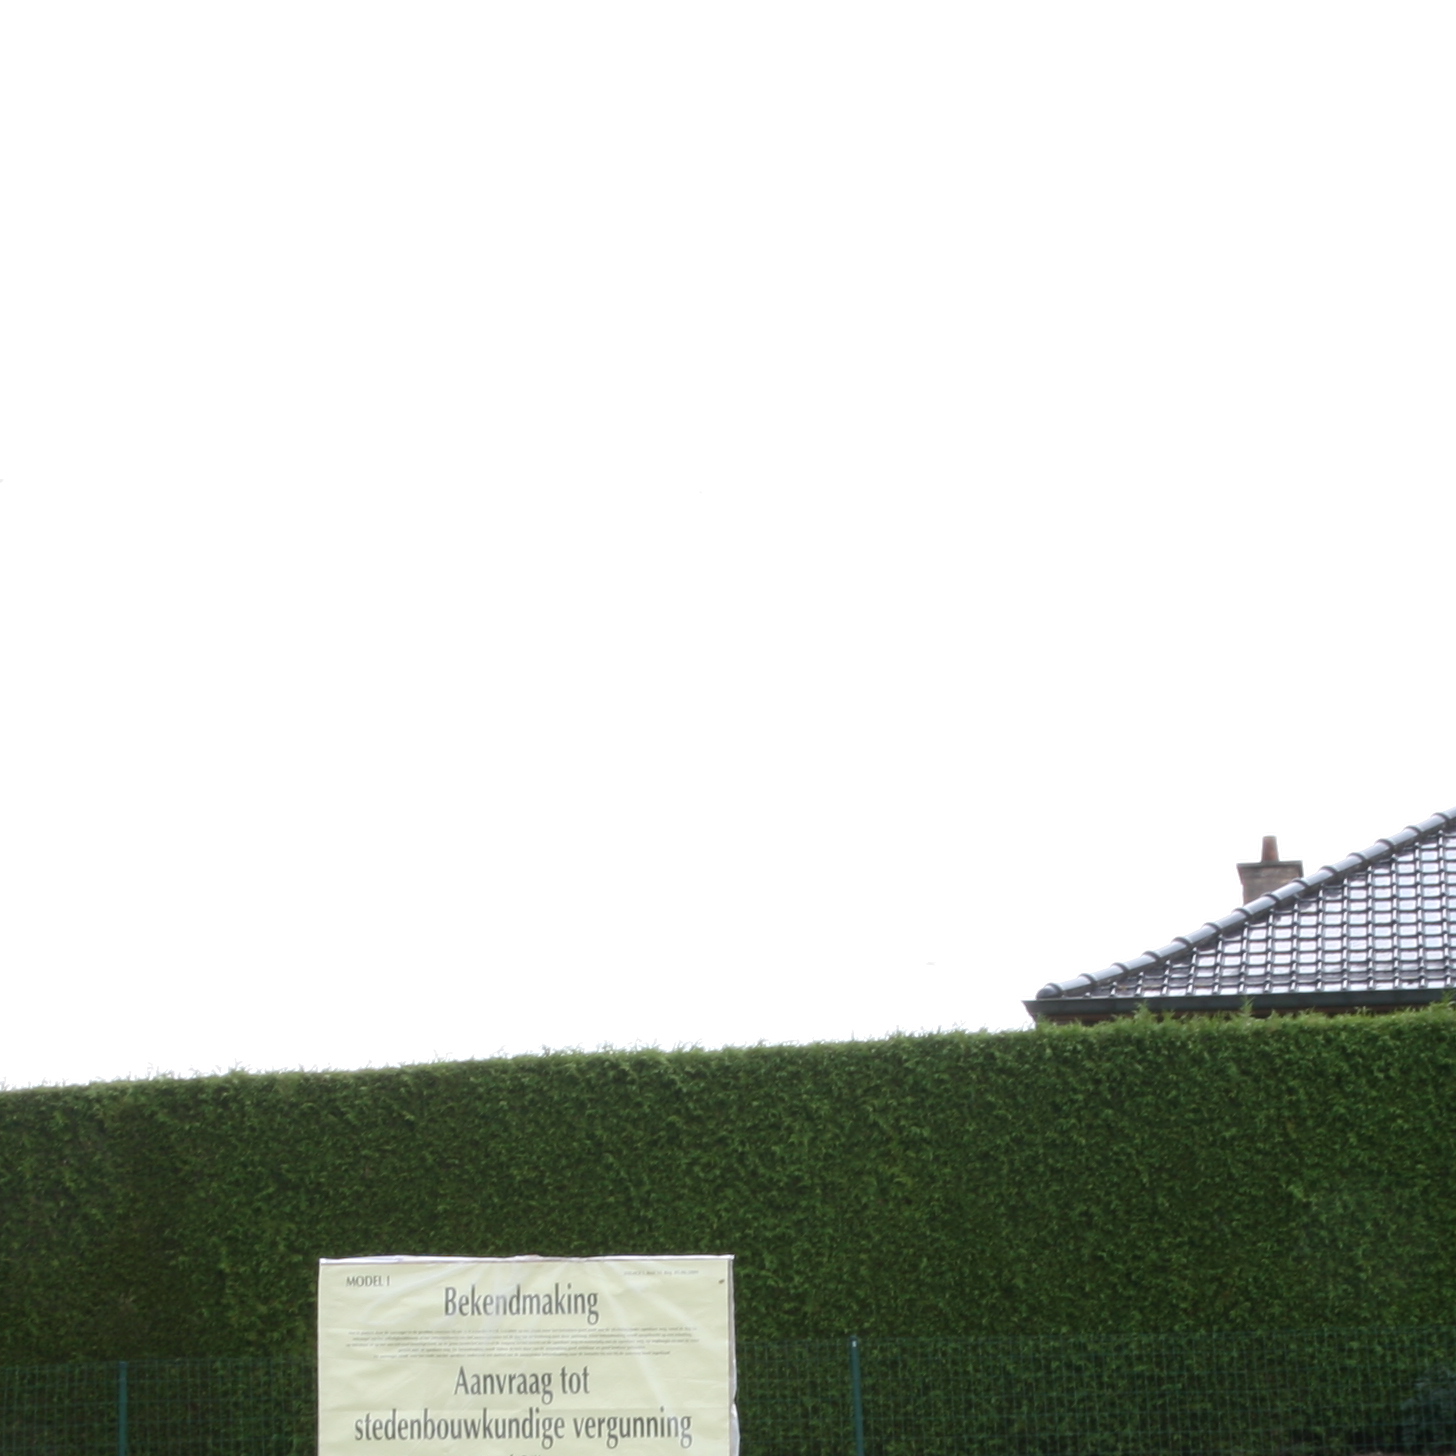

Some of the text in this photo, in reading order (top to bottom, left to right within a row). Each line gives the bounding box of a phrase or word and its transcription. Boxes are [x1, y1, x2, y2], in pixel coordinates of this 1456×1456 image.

[346, 1275, 384, 1287] MODEL
[444, 1283, 600, 1325] Bekendmaking
[454, 1366, 590, 1404] Aanvraag tot
[355, 1407, 693, 1450] stedenbouwkundige vergunning
